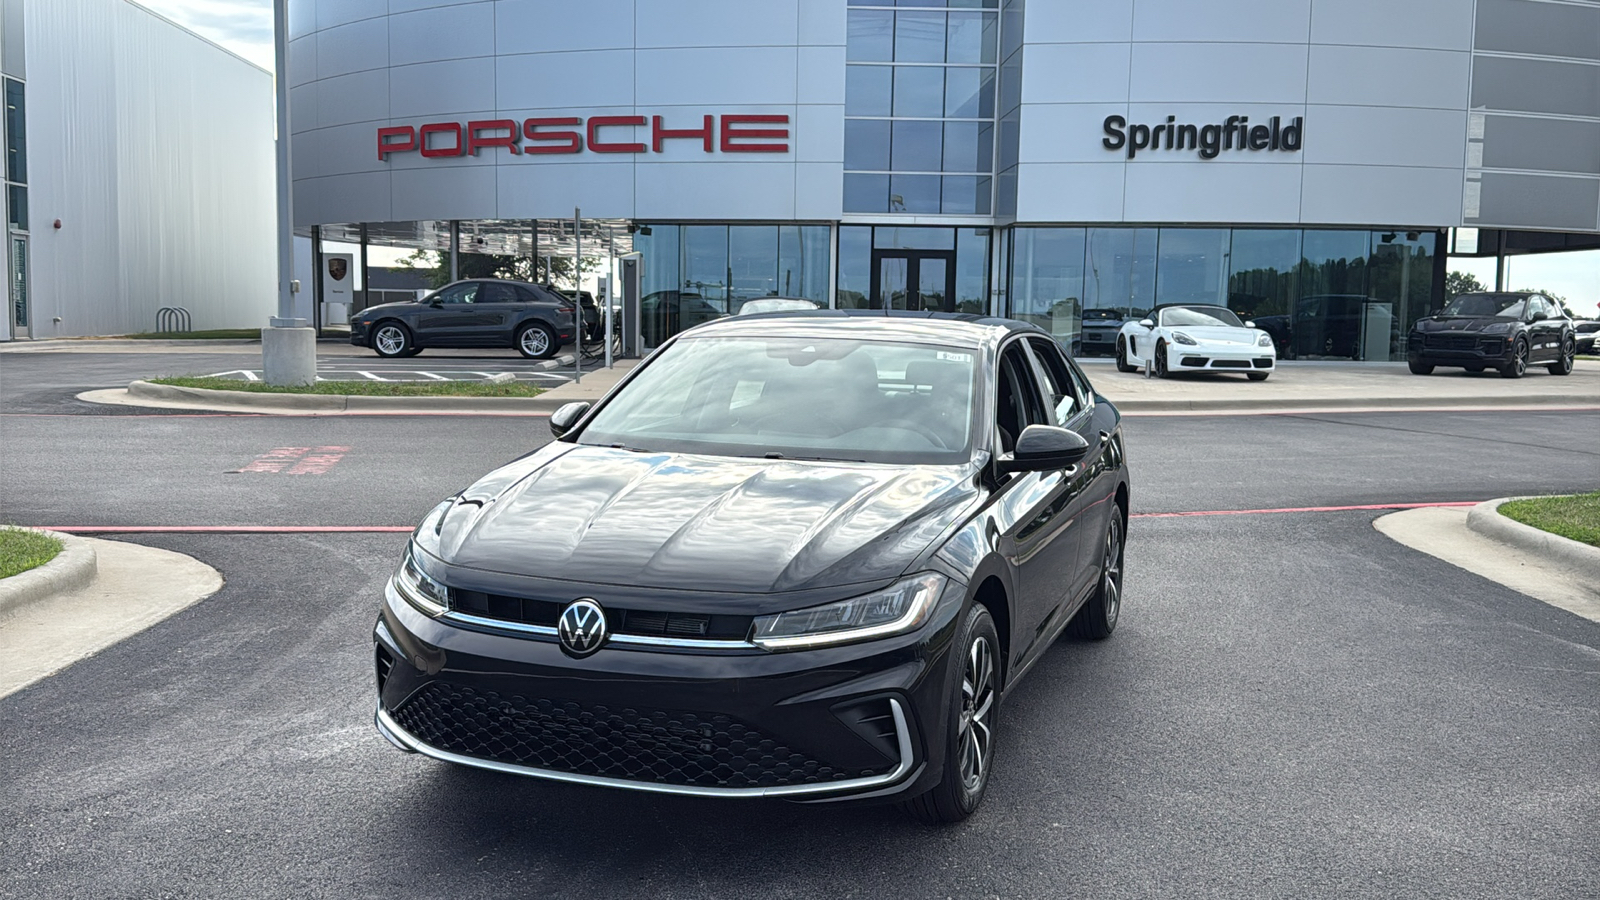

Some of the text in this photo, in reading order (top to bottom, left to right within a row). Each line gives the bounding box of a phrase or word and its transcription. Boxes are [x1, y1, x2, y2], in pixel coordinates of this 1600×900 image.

[377, 114, 789, 161] PORSCHE
[1102, 115, 1303, 159] Springfield
[561, 603, 604, 650] VW
